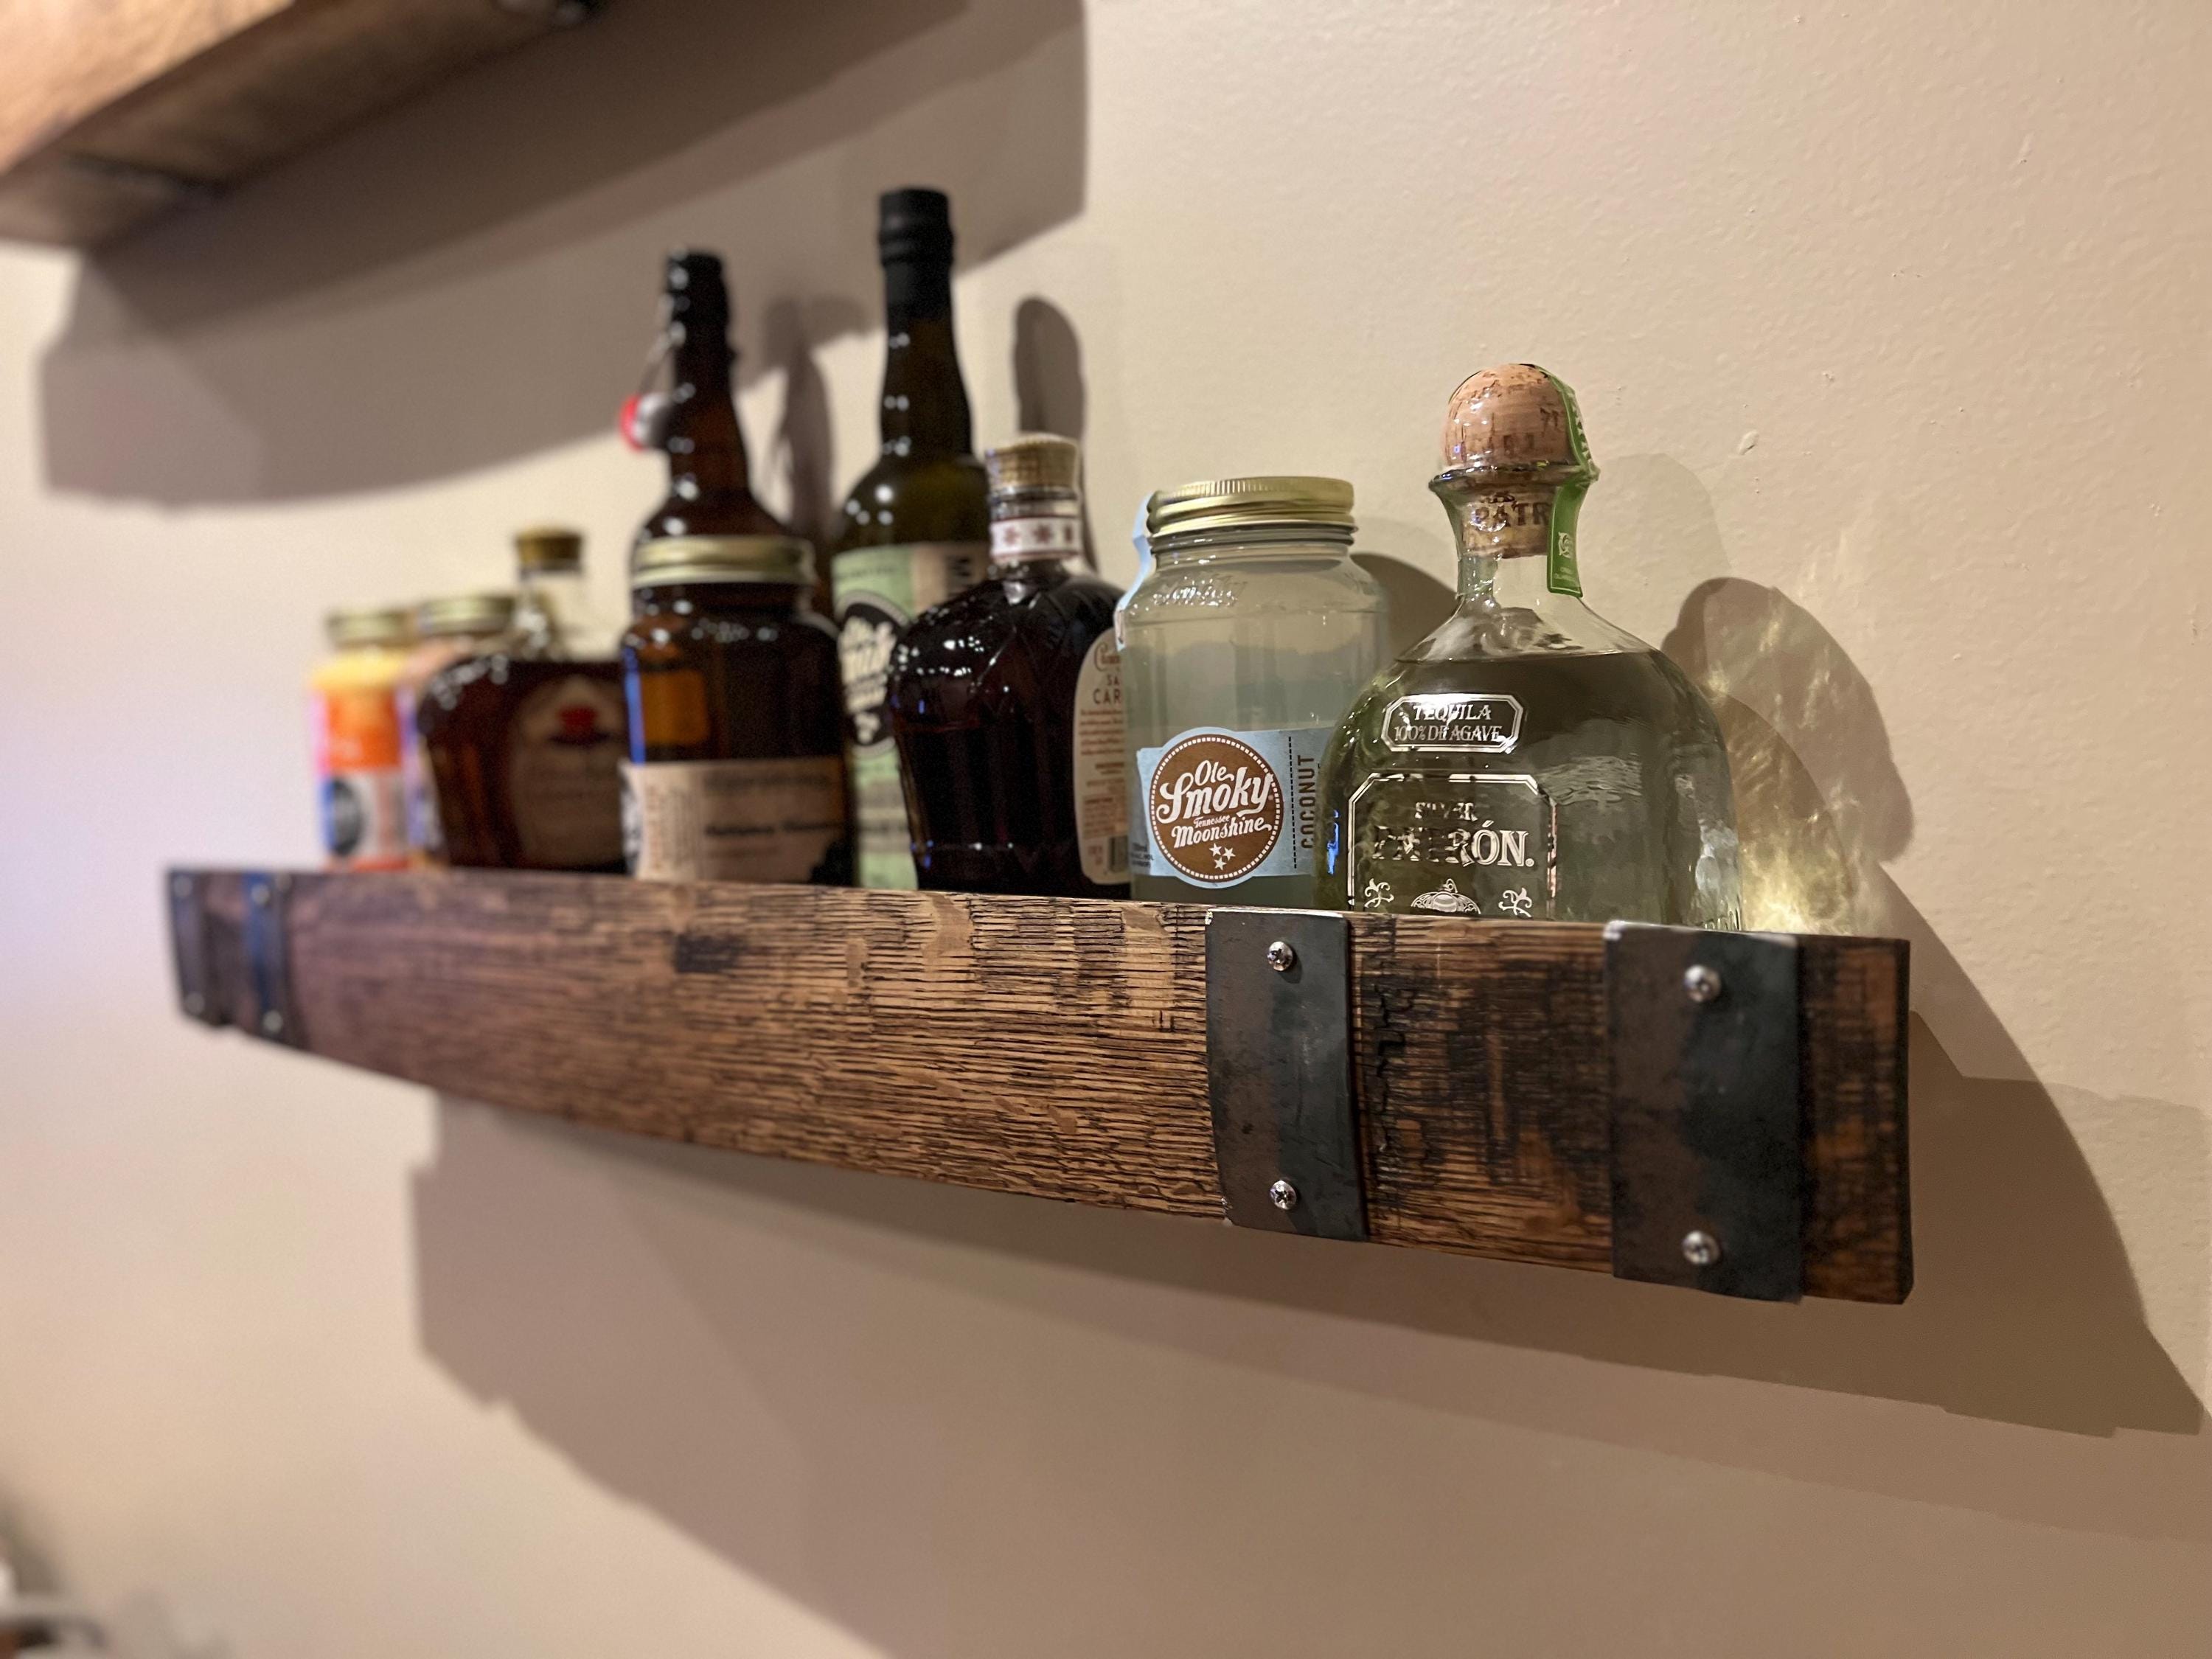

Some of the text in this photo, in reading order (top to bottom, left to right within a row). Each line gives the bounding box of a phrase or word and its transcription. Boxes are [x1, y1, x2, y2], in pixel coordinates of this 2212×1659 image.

[1473, 502, 1551, 527] PATR
[1413, 704, 1492, 722] TEQUILA
[1394, 726, 1503, 742] 100% DE AGAVE
[1194, 759, 1235, 786] Ole
[1156, 766, 1275, 824] Smoky
[1298, 754, 1316, 849] COCONUT
[1194, 815, 1231, 828] Tennessee
[1415, 802, 1478, 821] SVER
[1171, 816, 1273, 849] Moonshine
